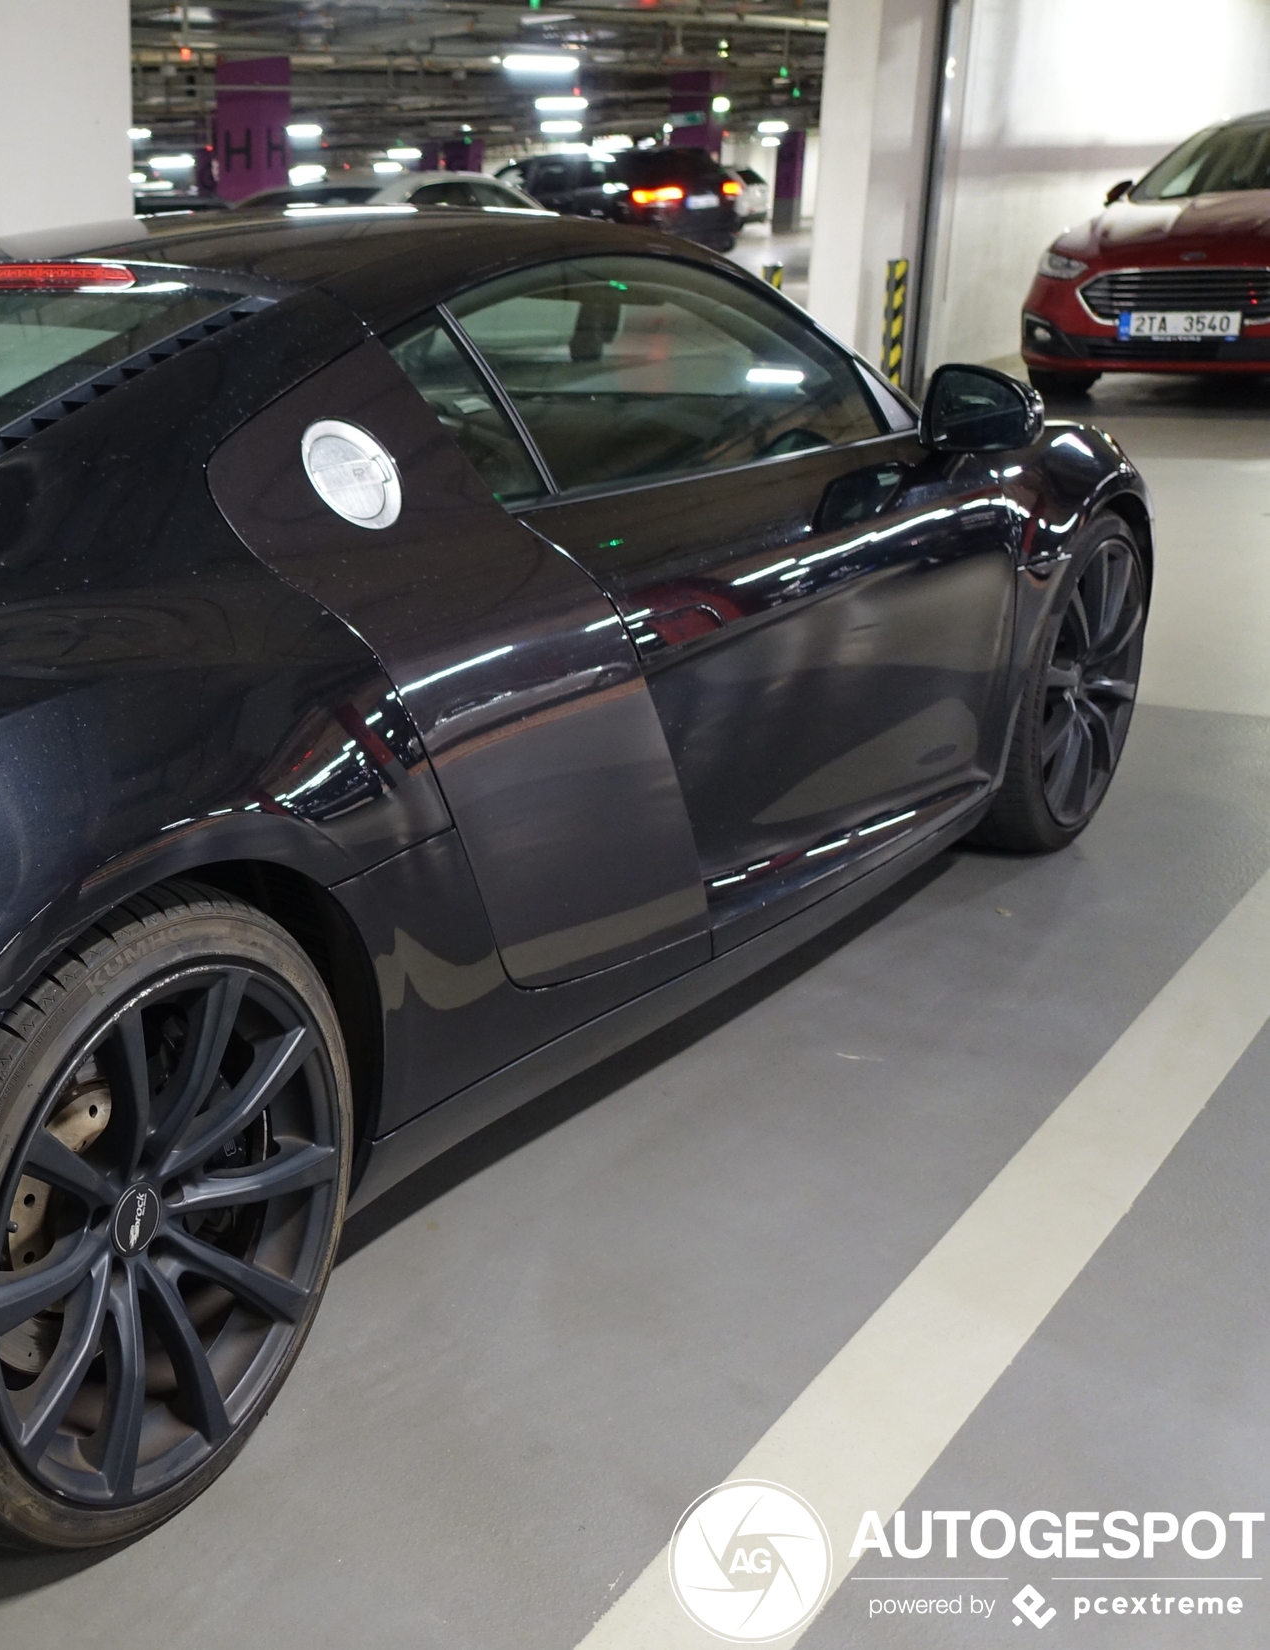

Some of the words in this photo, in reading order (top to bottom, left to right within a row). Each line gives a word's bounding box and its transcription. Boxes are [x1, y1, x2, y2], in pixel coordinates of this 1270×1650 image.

[225, 129, 251, 171] H
[1134, 316, 1168, 333] 2TA
[1183, 315, 1231, 333] 3540
